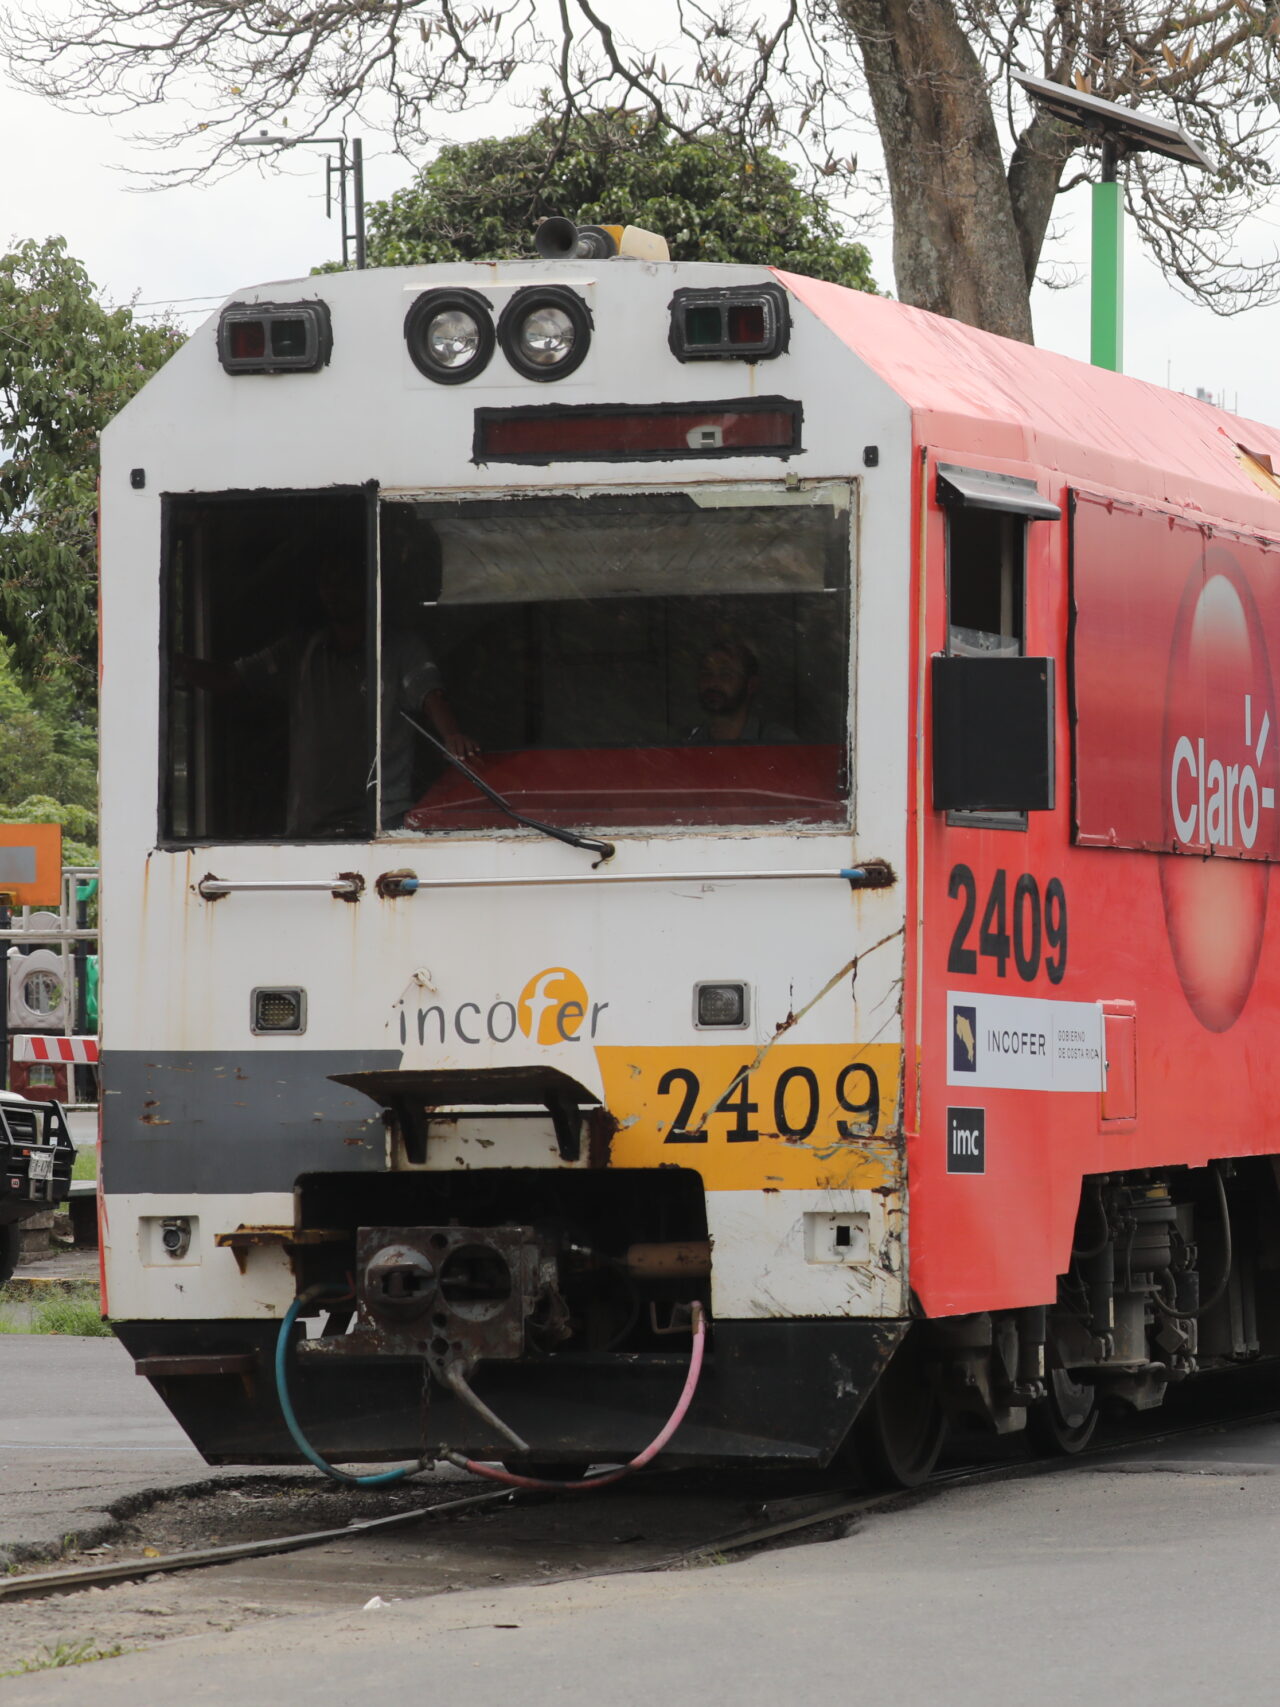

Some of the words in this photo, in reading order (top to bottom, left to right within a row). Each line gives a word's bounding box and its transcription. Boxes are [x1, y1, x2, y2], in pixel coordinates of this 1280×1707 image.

[1171, 735, 1259, 849] Claro
[946, 863, 1067, 985] 2409
[399, 970, 609, 1046] incofer
[1058, 1030, 1086, 1042] GOBIERNO
[987, 1030, 1046, 1056] INCOFER
[1058, 1047, 1066, 1058] DE
[1067, 1048, 1084, 1059] COSTA
[1085, 1049, 1099, 1059] RICA
[656, 1062, 881, 1144] 2409
[953, 1119, 979, 1156] imc
